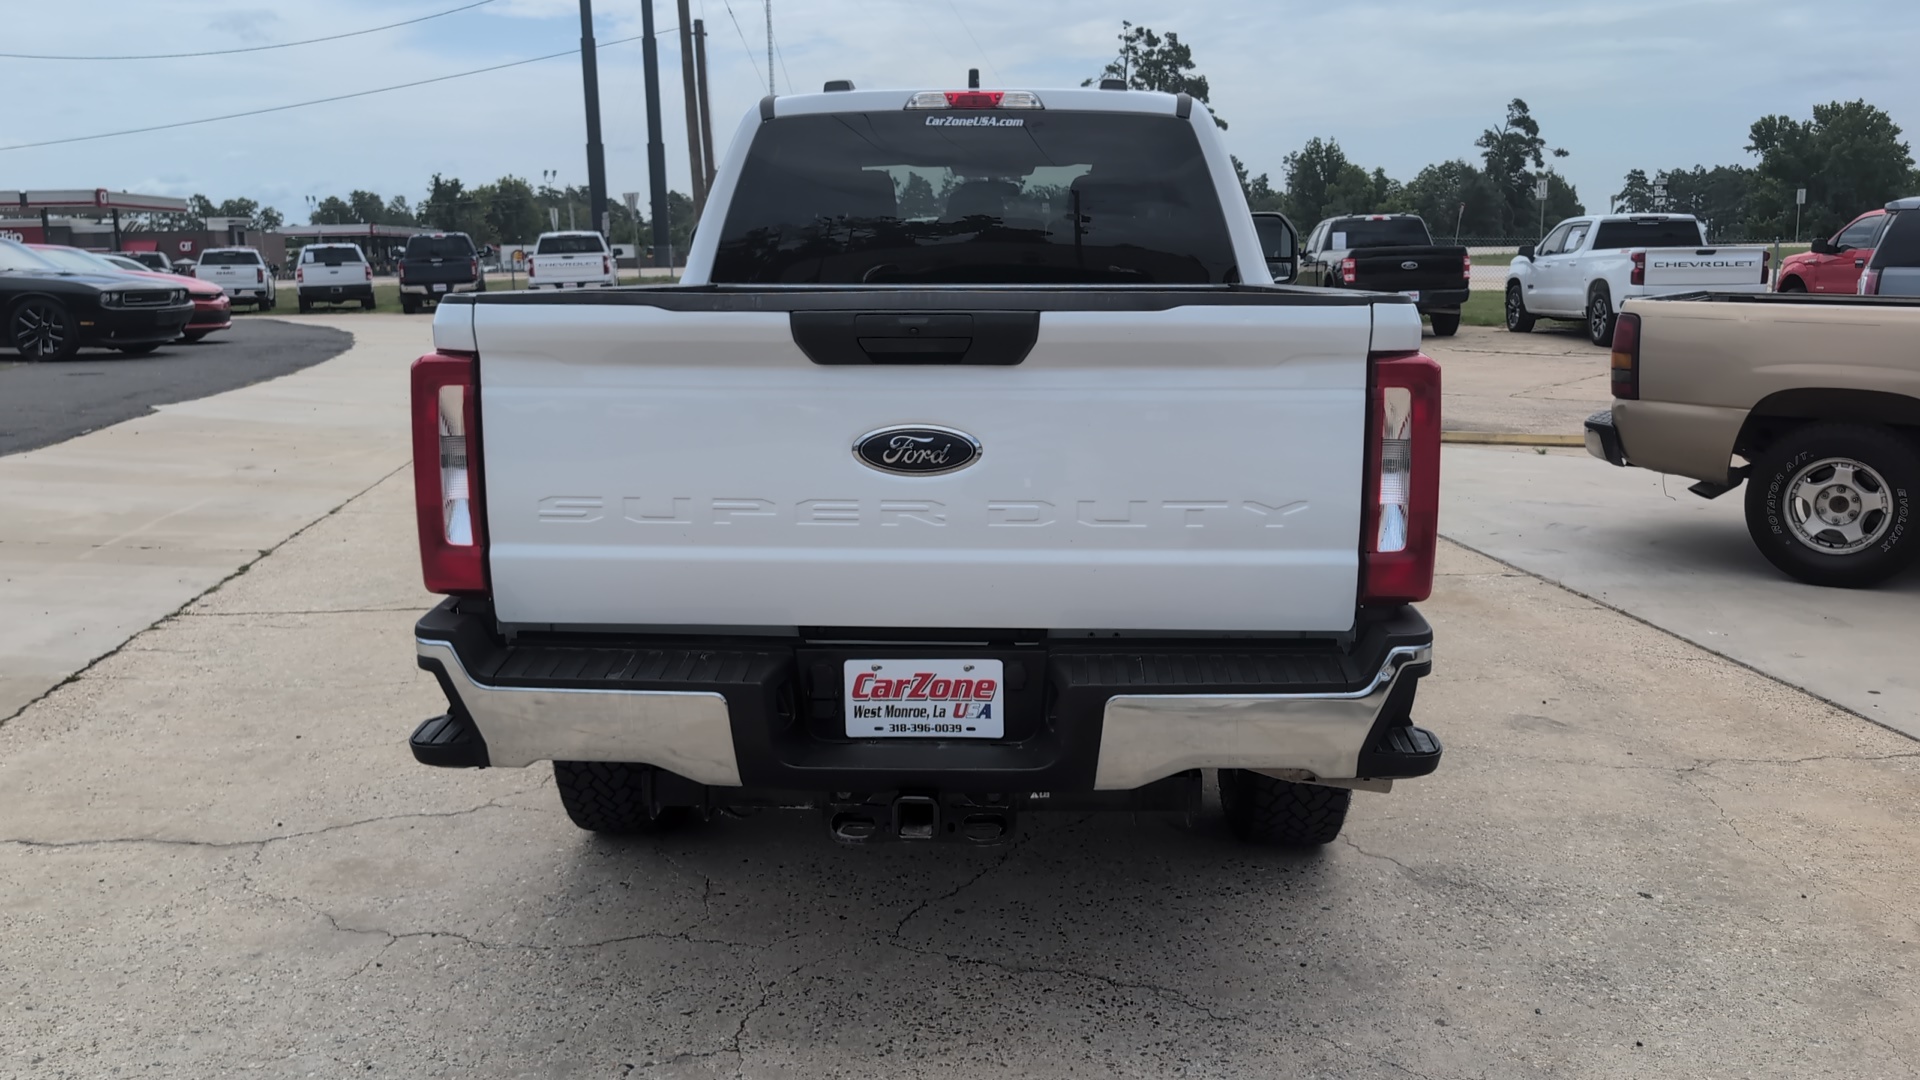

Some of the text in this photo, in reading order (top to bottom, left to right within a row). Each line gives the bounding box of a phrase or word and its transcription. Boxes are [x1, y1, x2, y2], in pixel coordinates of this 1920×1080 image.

[925, 116, 1024, 126] CarZoneUSA.com
[1654, 260, 1756, 268] CHEVROLET
[882, 435, 952, 464] Ford
[538, 496, 1309, 528] SUPER DUTY
[1880, 488, 1909, 553] EVOLUXX
[851, 672, 998, 702] CarZone
[854, 704, 946, 720] West Monroe, La
[952, 702, 992, 720] USA
[889, 723, 962, 733] 318-396-0039
